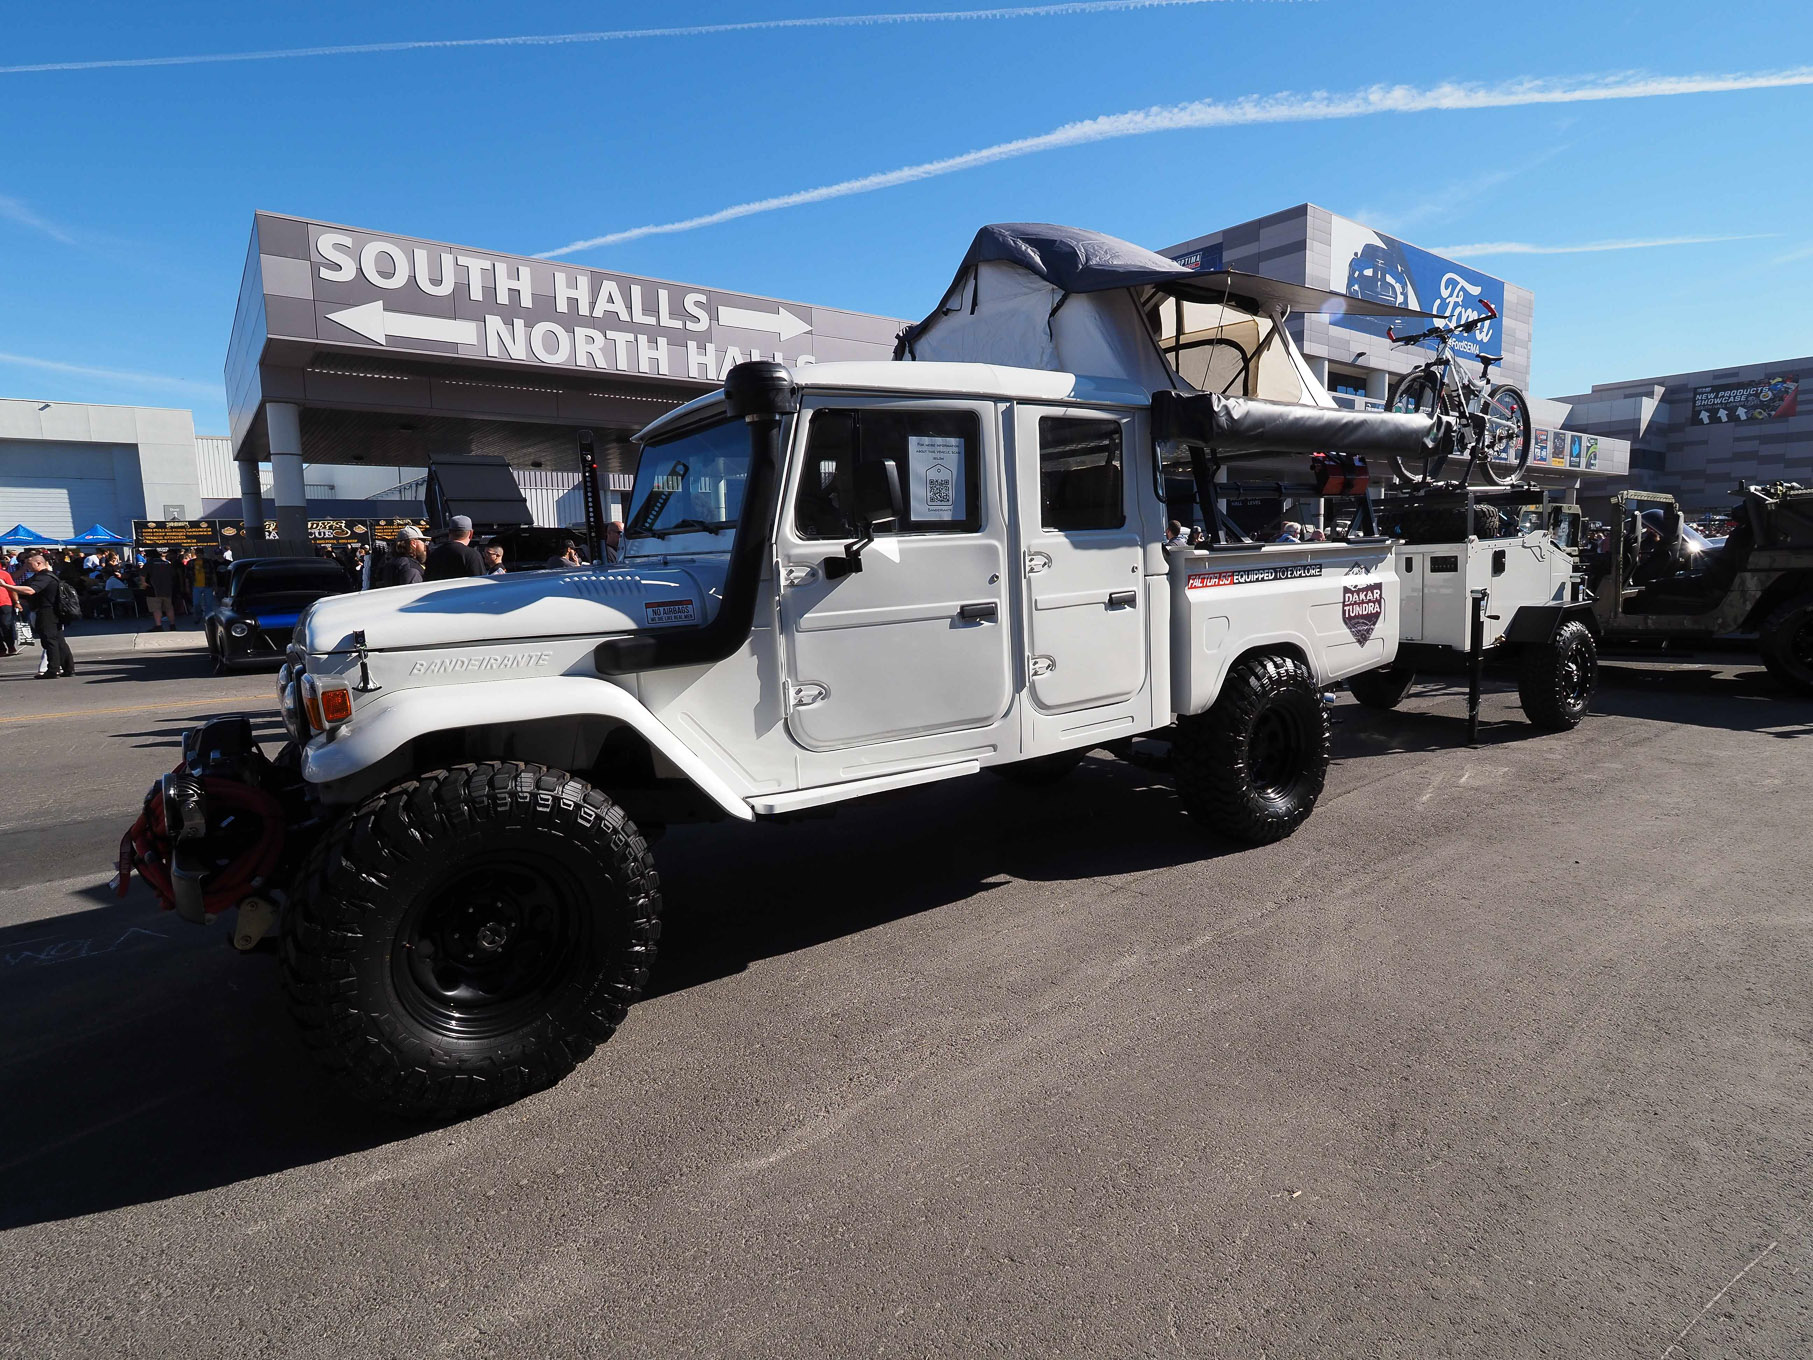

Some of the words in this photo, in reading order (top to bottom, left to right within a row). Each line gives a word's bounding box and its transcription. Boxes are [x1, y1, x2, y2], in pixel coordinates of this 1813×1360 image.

[1177, 254, 1200, 266] OPTIMA
[317, 233, 533, 309] SOUTH
[553, 271, 710, 332] HALLS
[1432, 272, 1493, 343] Ford
[484, 314, 669, 376] NORTH
[1696, 392, 1716, 401] NEW
[1718, 387, 1769, 398] PRODUCTS
[1696, 395, 1747, 406] SHOWCASE
[1188, 575, 1220, 588] FACTOR
[1219, 572, 1233, 585] 55
[1233, 570, 1275, 583] EQUIPPED
[1276, 567, 1287, 579] TO
[1344, 589, 1381, 605] DAKAR
[652, 608, 661, 616] NO
[662, 606, 689, 615] AIRBAGS
[1344, 602, 1381, 618] TUNDRA
[408, 651, 553, 676] BANDEIRANTE
